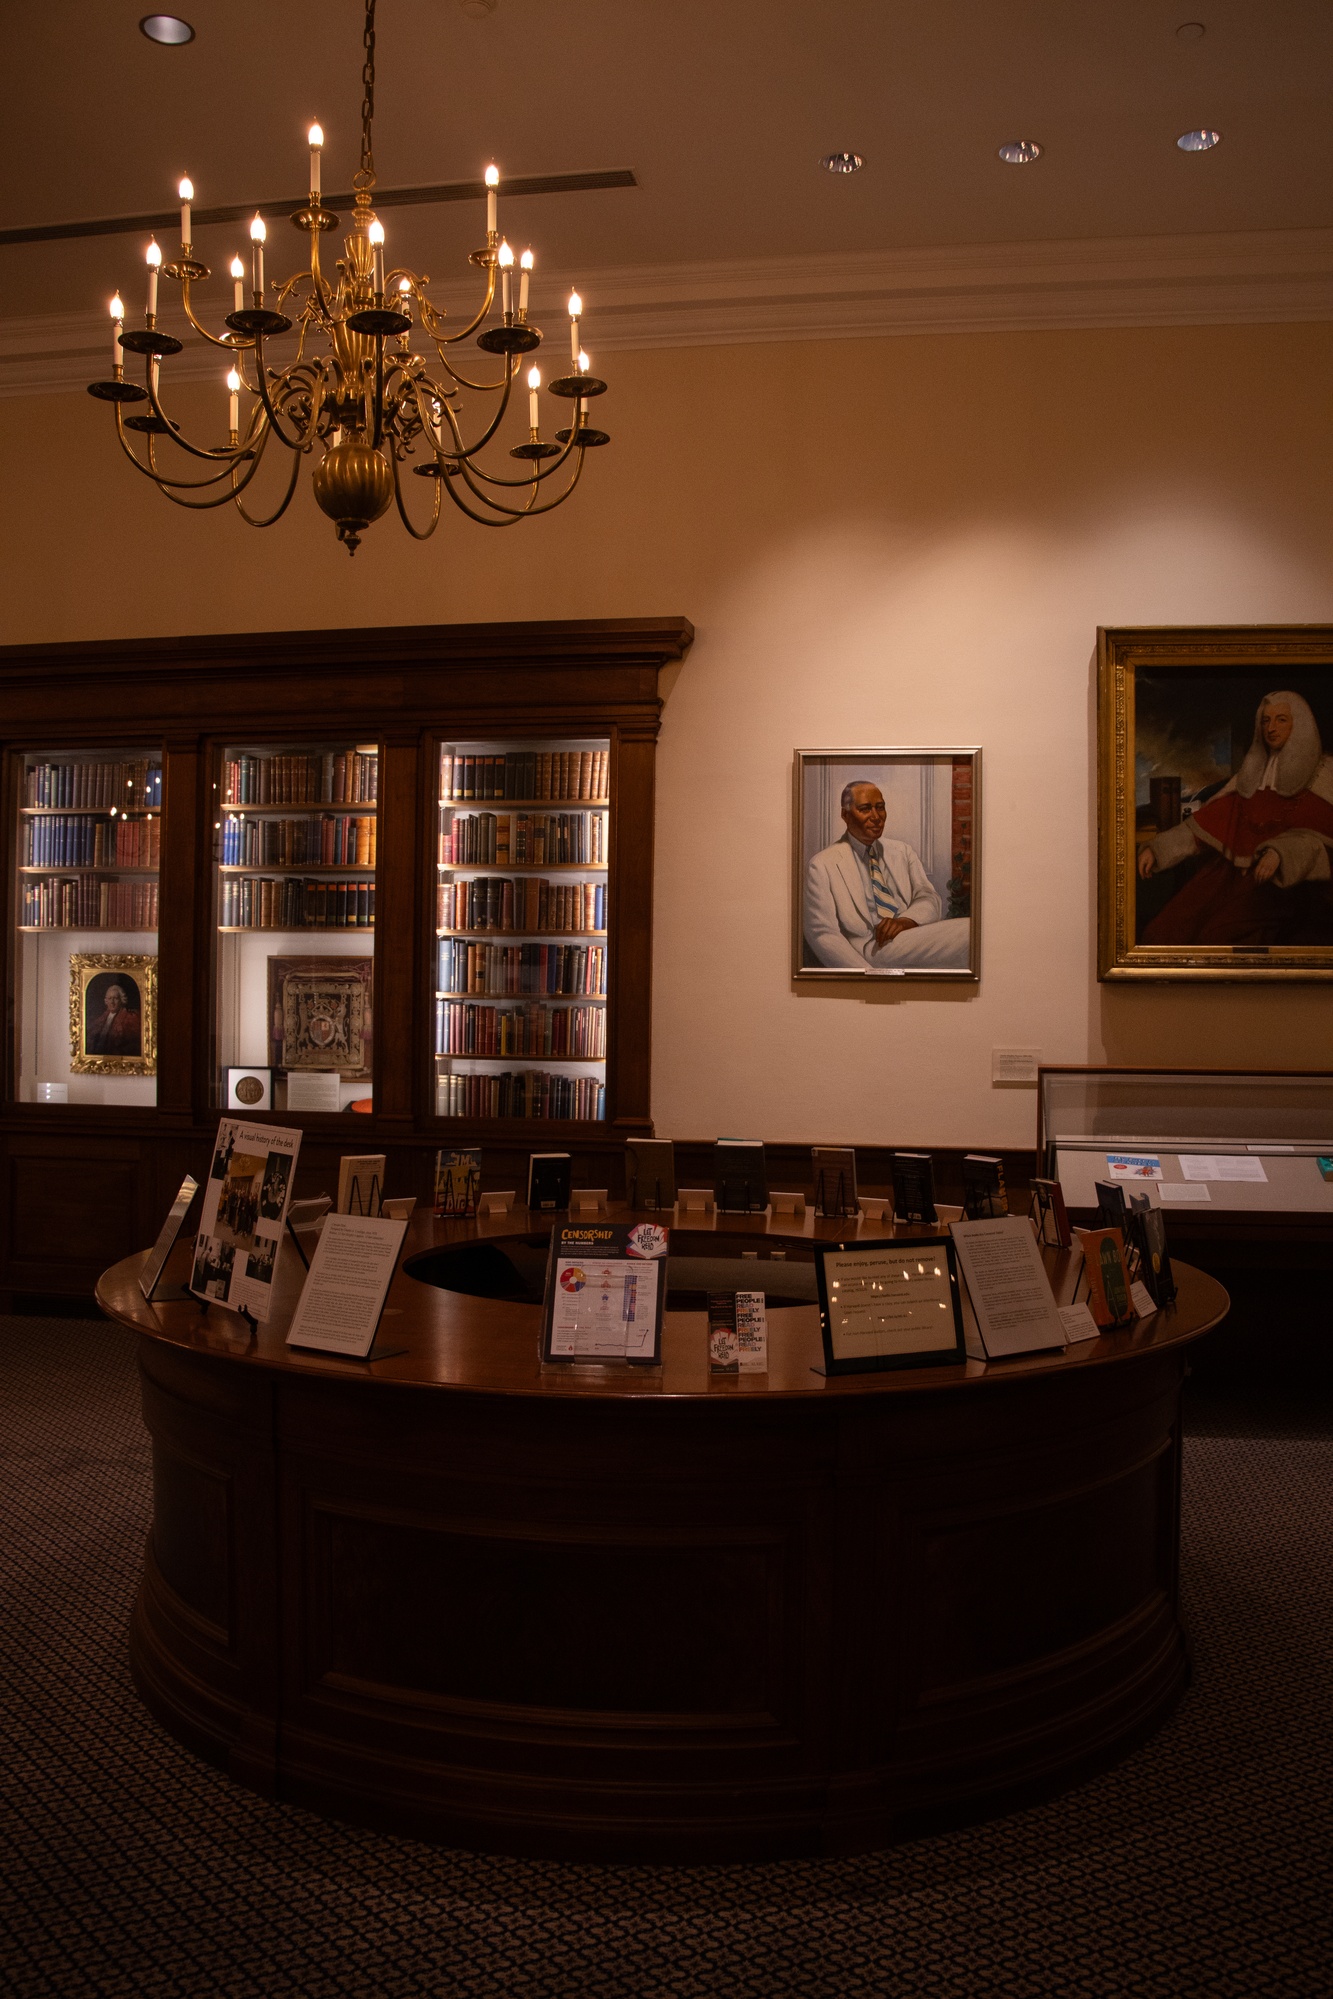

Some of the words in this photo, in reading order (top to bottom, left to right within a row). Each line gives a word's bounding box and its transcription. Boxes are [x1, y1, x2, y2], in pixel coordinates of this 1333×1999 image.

[244, 1132, 256, 1141] visual
[256, 1132, 270, 1146] history
[271, 1136, 276, 1144] of
[284, 1139, 294, 1148] desk
[562, 1229, 613, 1241] CENSORSHIP
[638, 1234, 659, 1243] FREEDOM
